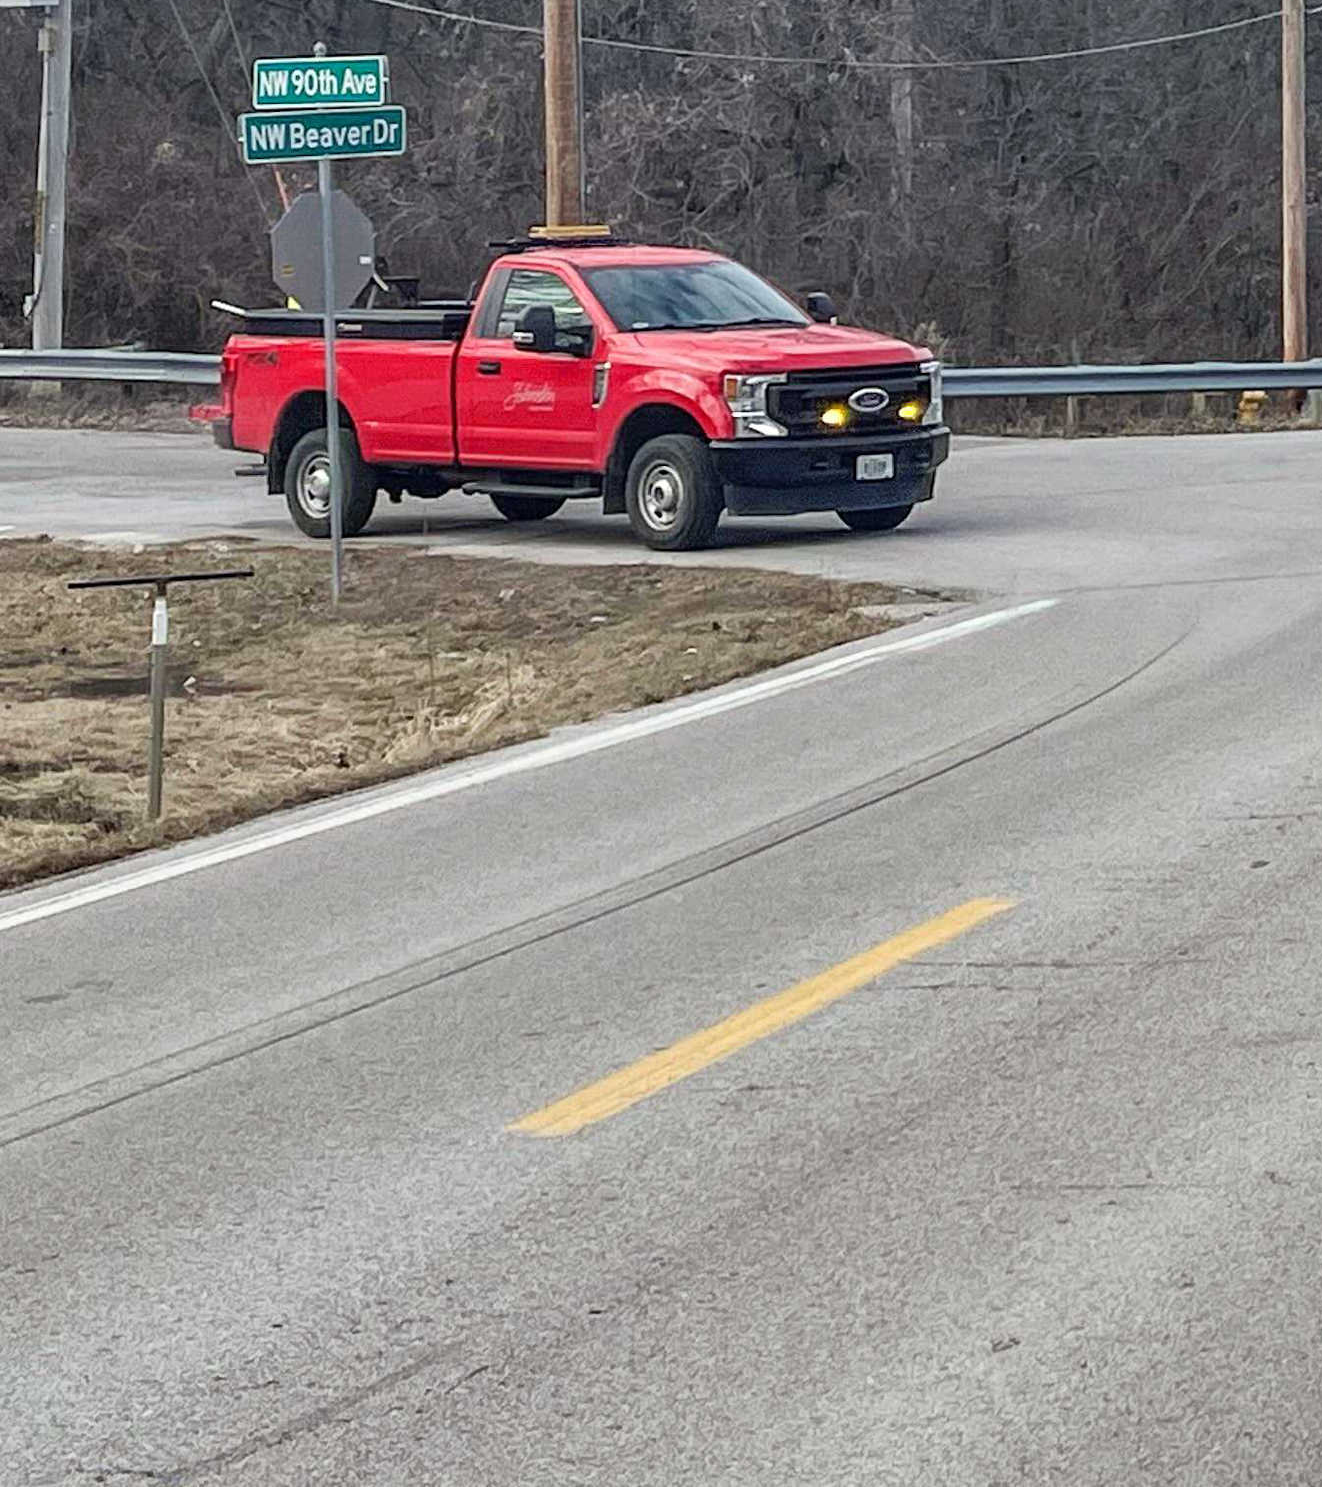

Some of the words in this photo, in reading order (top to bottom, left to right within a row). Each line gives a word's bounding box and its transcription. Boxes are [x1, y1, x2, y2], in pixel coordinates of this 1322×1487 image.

[259, 70, 288, 97] NW
[291, 69, 338, 96] 90th
[341, 68, 377, 95] Ave
[250, 123, 286, 151] NW
[290, 122, 371, 149] Beaver
[373, 118, 399, 144] Dr
